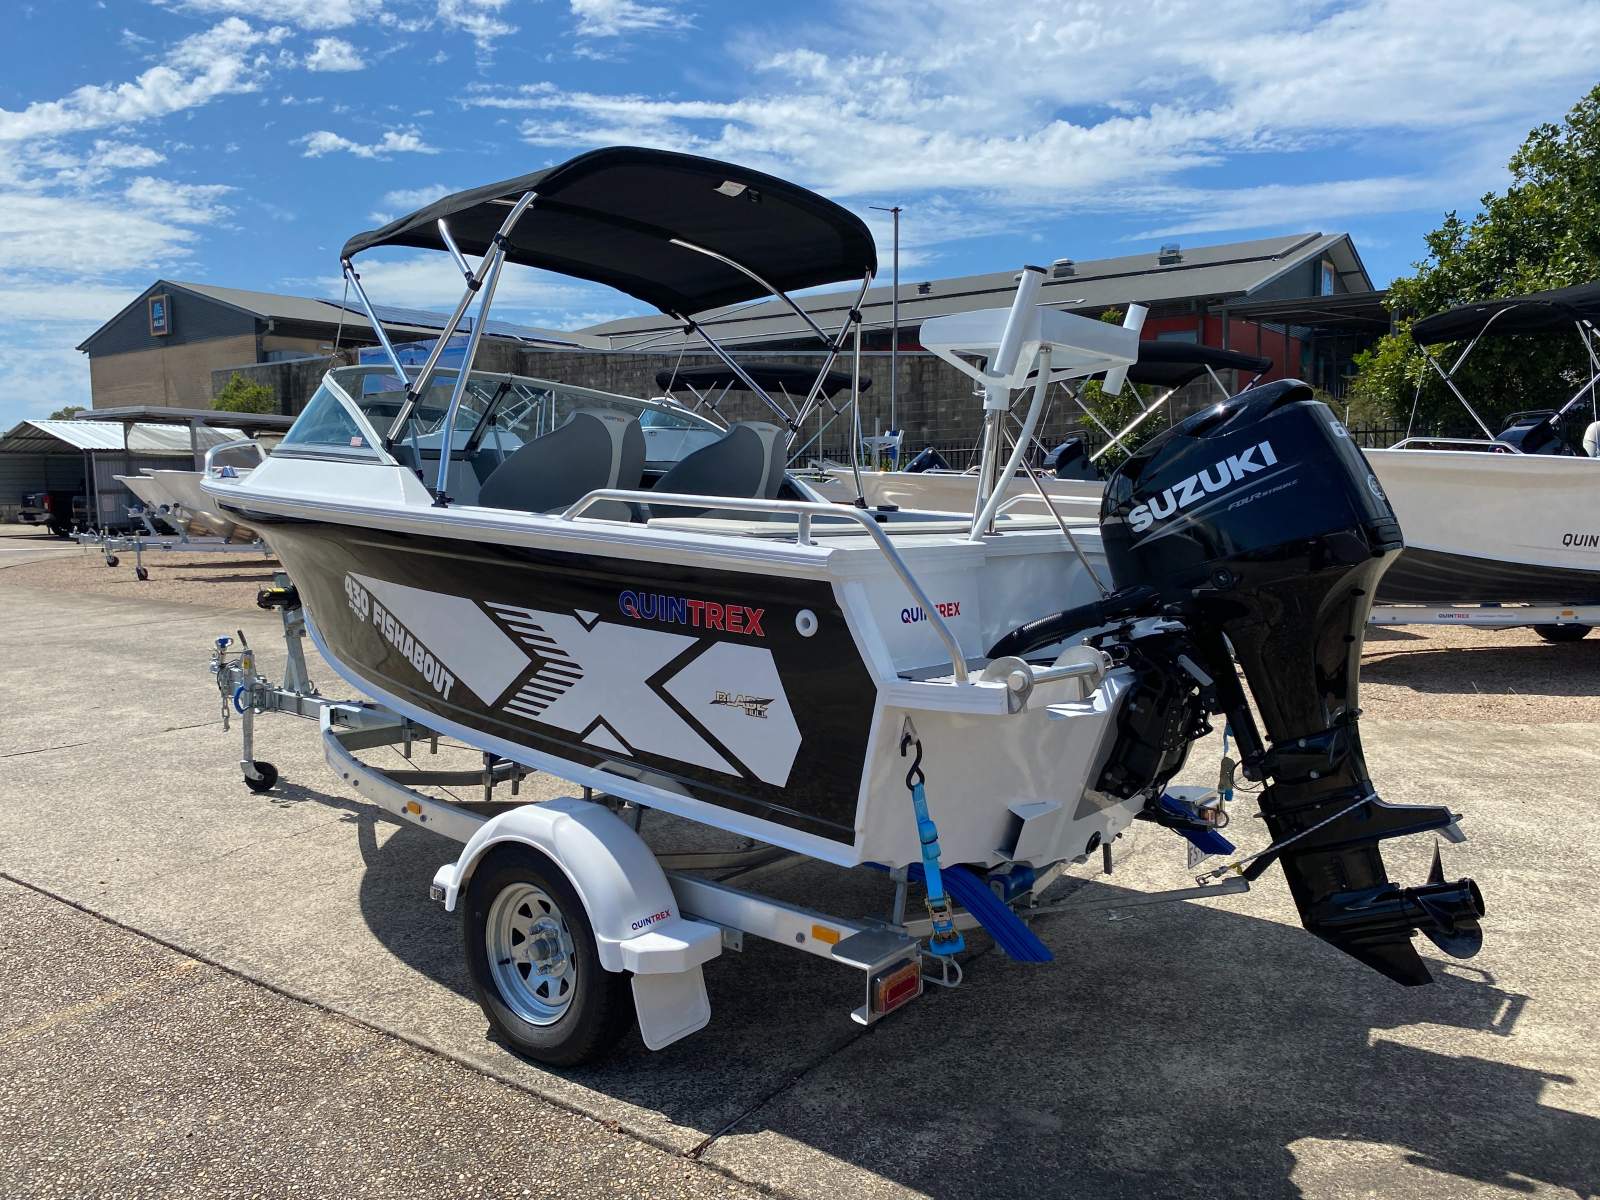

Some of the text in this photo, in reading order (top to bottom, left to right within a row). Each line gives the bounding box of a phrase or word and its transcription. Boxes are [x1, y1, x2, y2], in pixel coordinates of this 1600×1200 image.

[1128, 440, 1278, 533] SUZUKI
[1562, 533, 1600, 547] QUIN
[618, 590, 765, 637] QUINTREX
[901, 602, 961, 624] QUIREX
[344, 575, 455, 701] 430 FISHABOUT
[631, 910, 671, 931] QUINTREX
